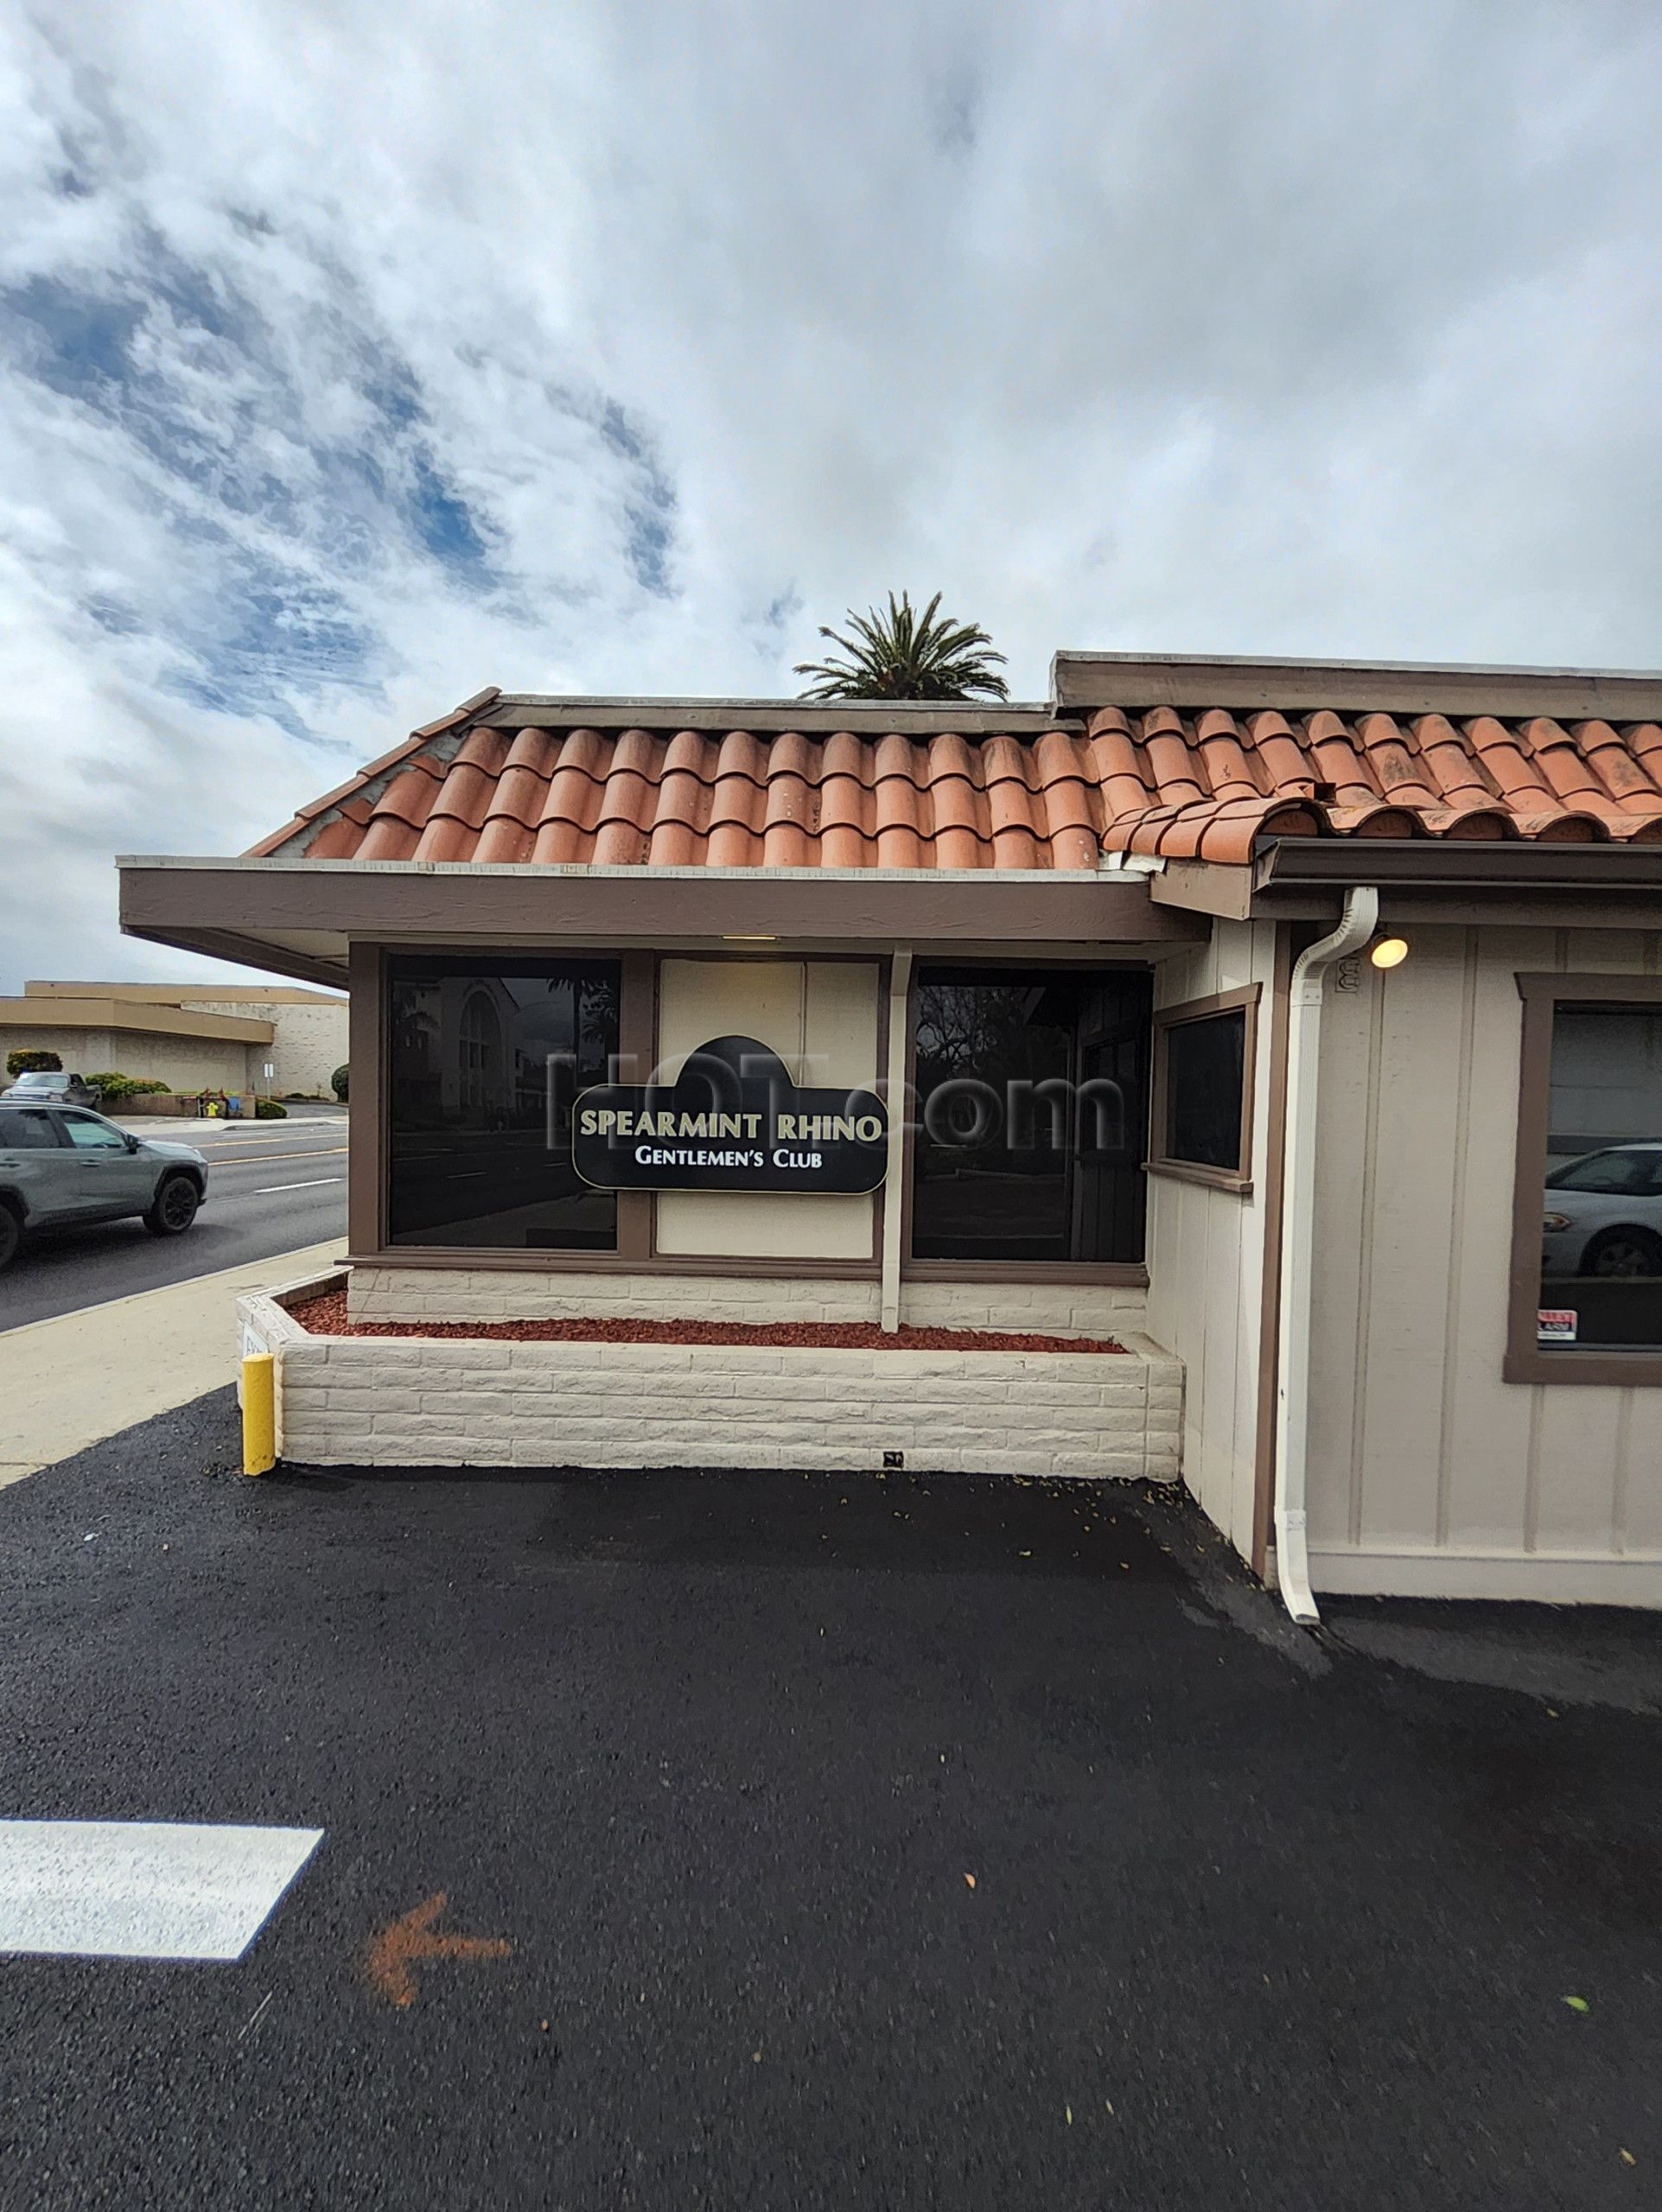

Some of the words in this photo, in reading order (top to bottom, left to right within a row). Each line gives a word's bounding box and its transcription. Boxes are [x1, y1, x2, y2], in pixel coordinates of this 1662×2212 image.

[580, 1109, 762, 1138] SPEARMINT
[777, 1114, 882, 1142] RHINO
[773, 1148, 823, 1168] CLUB
